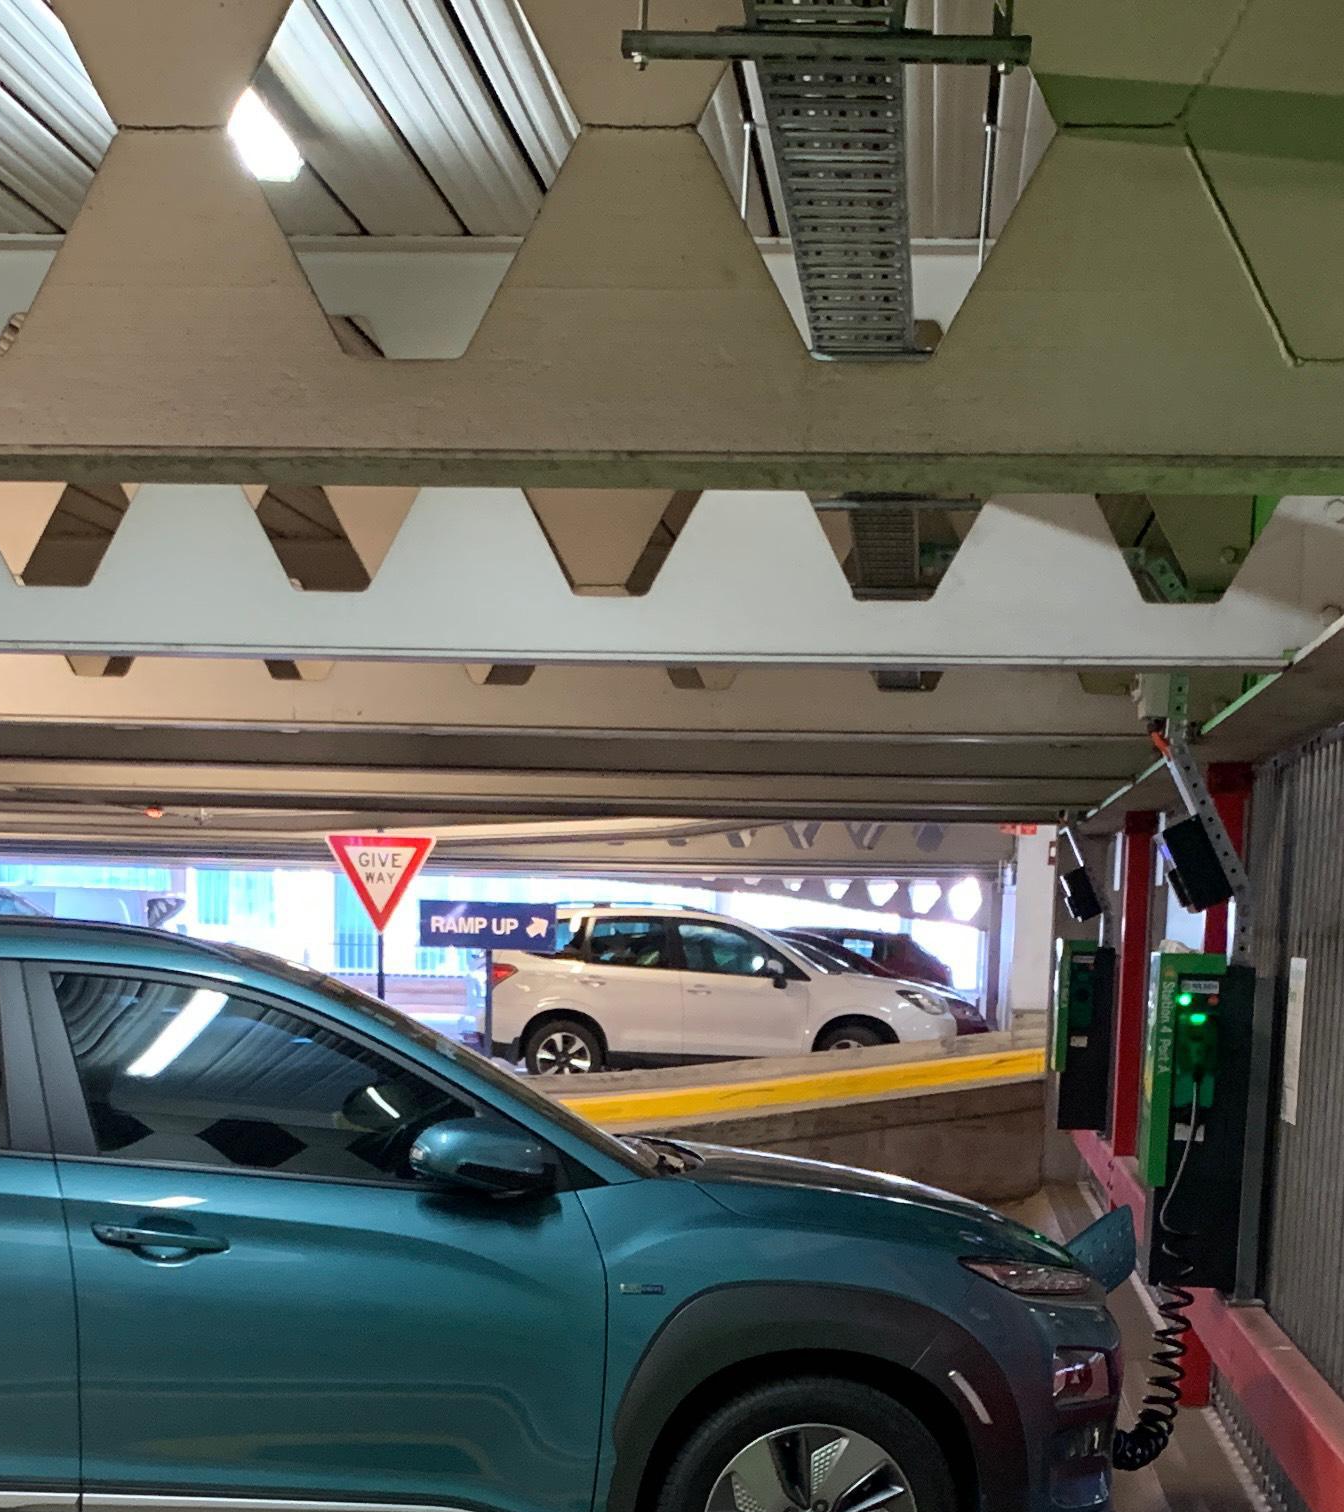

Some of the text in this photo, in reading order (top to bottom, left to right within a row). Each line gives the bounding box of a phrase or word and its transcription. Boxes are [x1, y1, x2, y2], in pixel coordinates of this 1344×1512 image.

[358, 852, 402, 869] GIVE
[364, 871, 396, 885] WAY
[430, 915, 519, 935] RAMP UP
